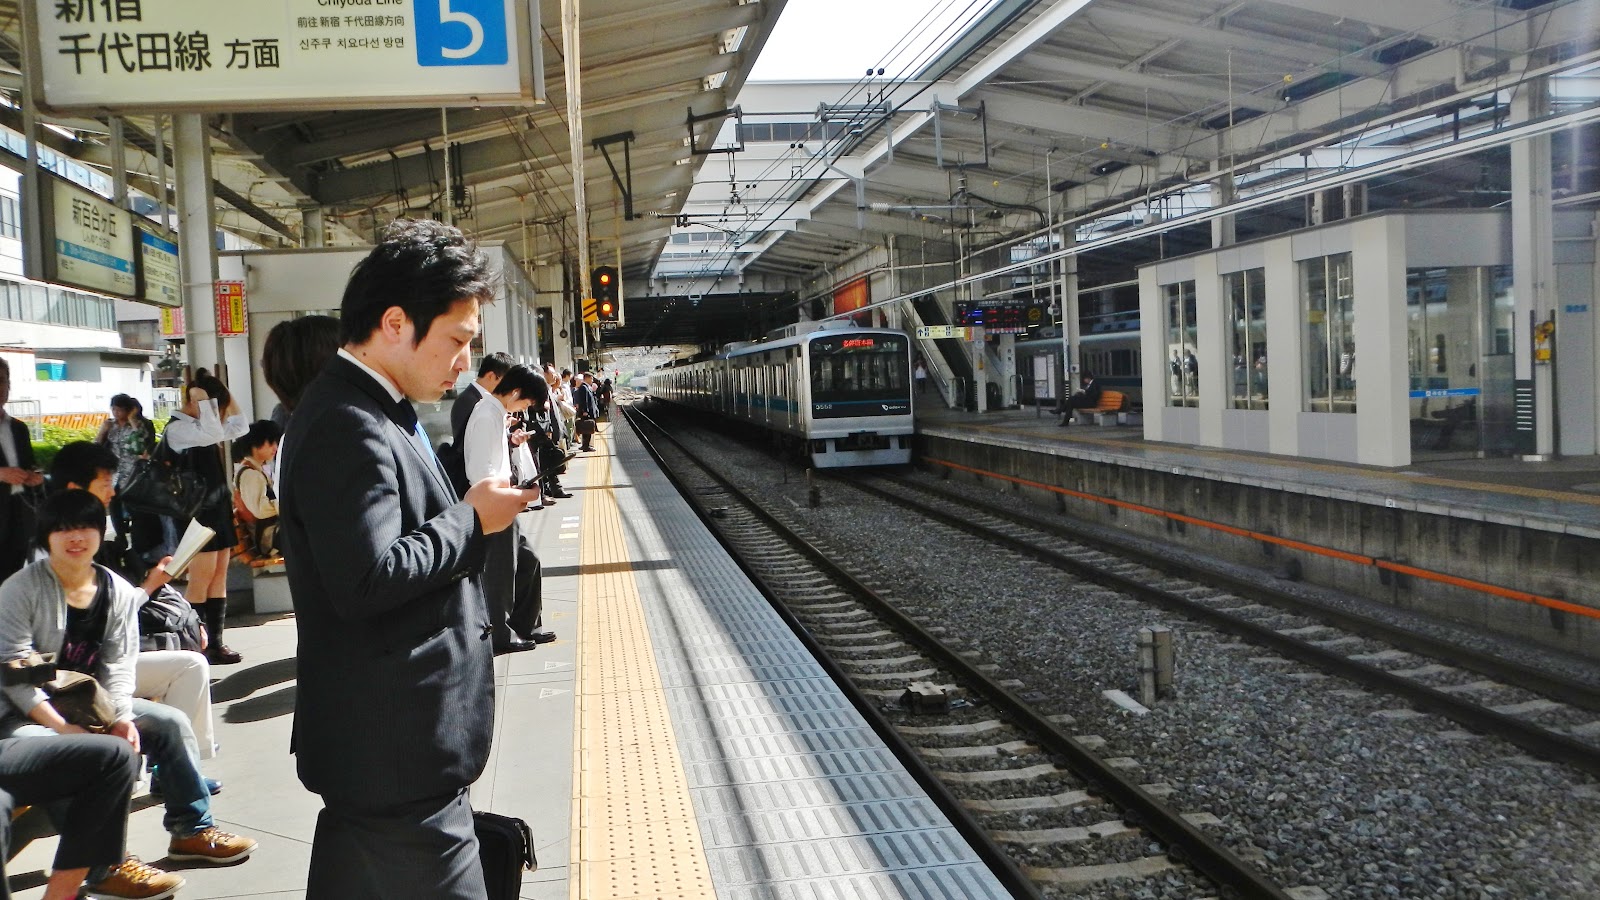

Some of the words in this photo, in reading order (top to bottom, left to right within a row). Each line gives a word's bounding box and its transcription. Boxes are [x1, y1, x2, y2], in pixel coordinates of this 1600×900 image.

[54, 0, 142, 23] 新宿
[297, 16, 318, 28] 前往
[320, 16, 340, 28] 新宿
[439, 0, 485, 59] 5
[59, 30, 212, 74] 千代田線
[224, 38, 280, 69] 方面
[300, 38, 332, 50] 신주쿠
[337, 37, 379, 49] 치요다선
